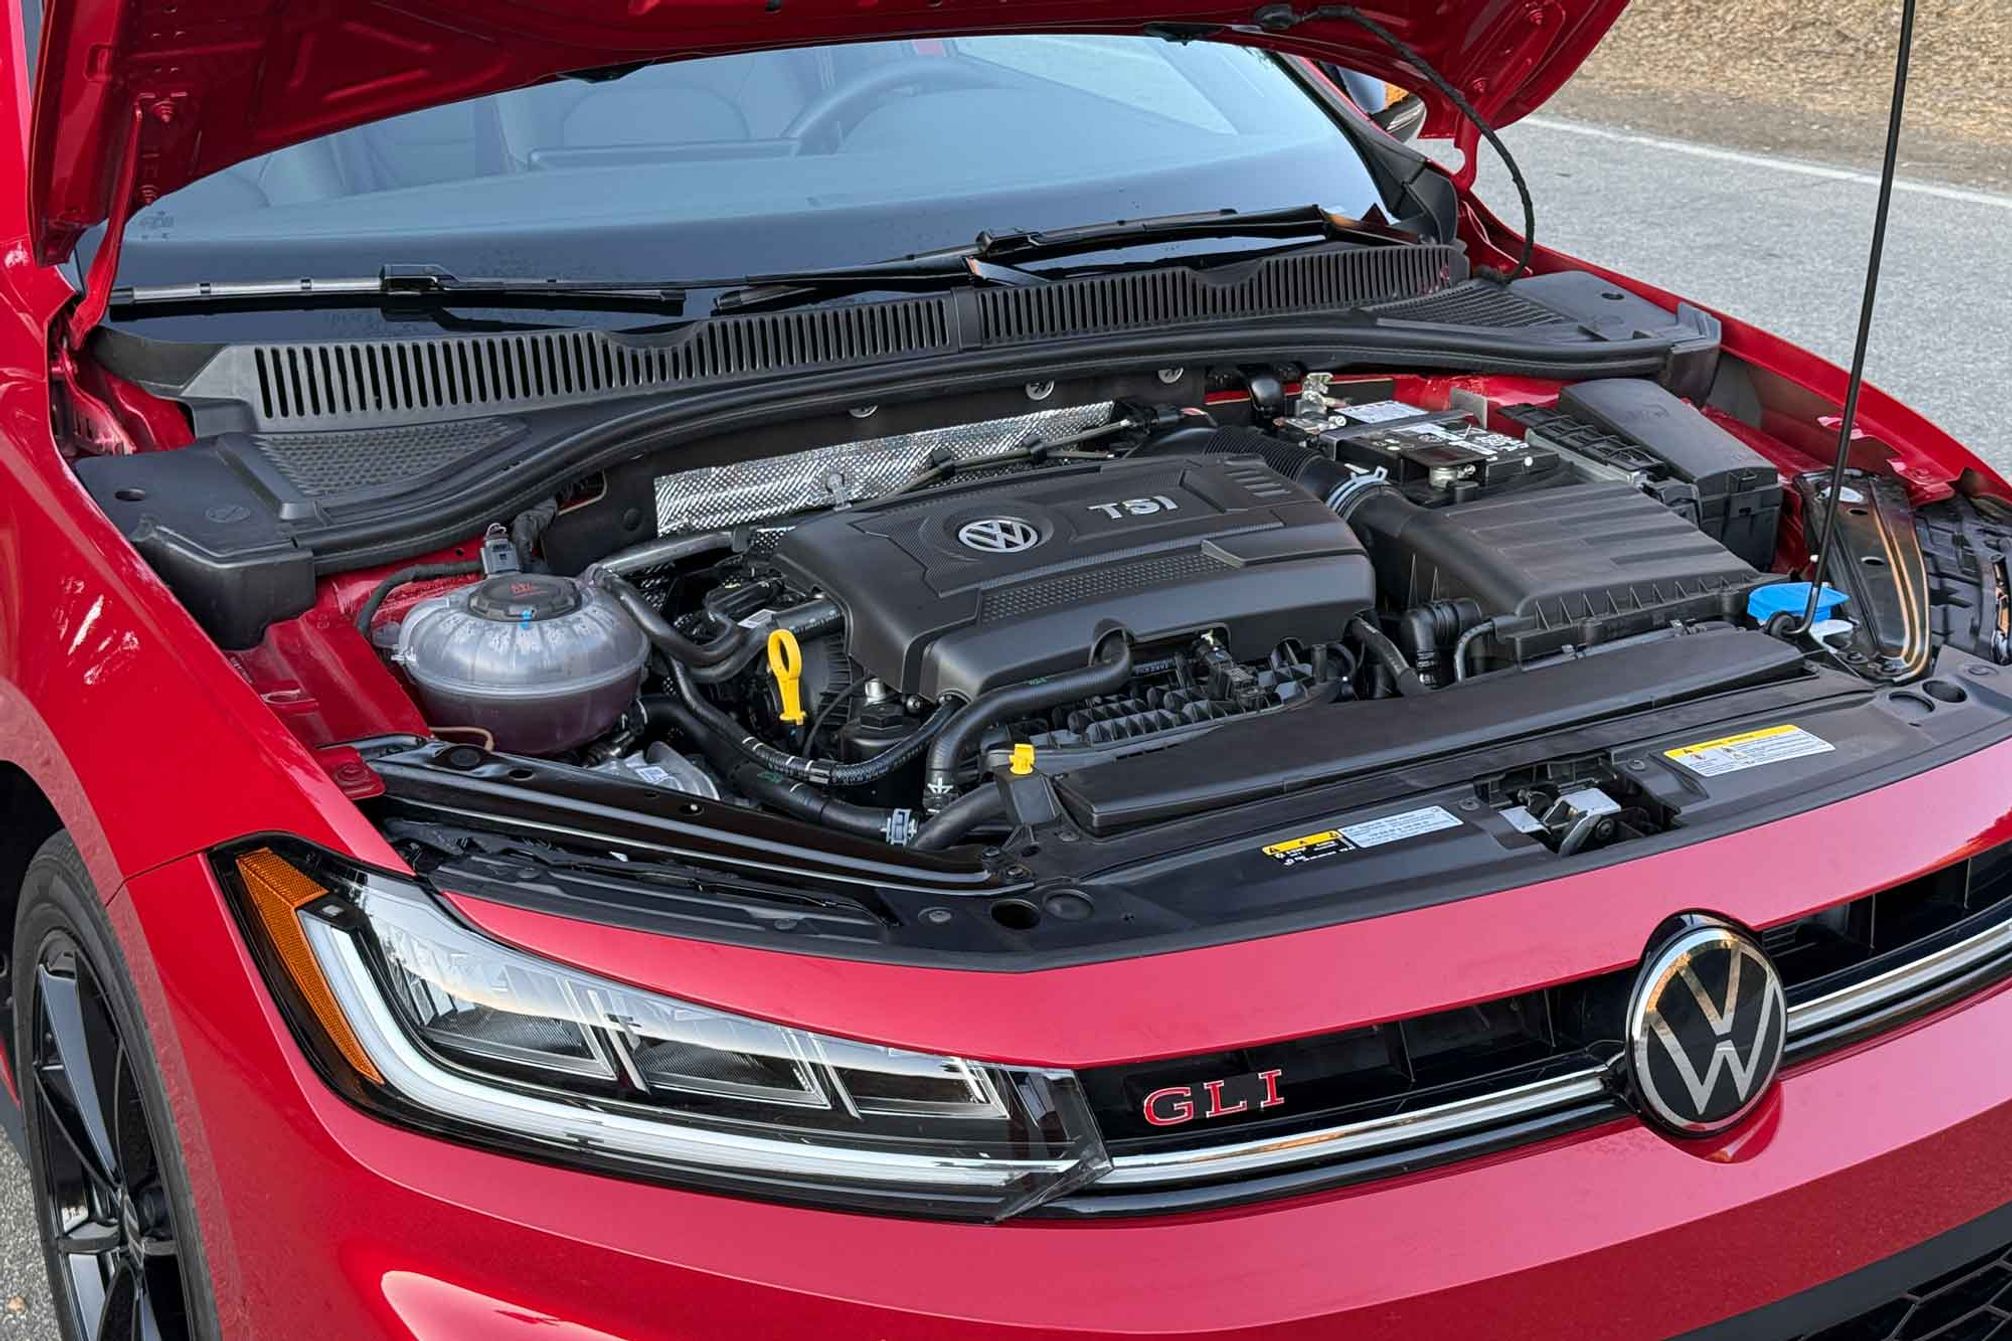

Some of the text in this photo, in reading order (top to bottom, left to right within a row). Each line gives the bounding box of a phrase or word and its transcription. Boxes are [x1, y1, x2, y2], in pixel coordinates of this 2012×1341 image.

[1087, 495, 1178, 519] TSI
[959, 520, 1038, 552] VW
[1634, 930, 1784, 1128] VW
[1143, 1069, 1285, 1126] GLI
